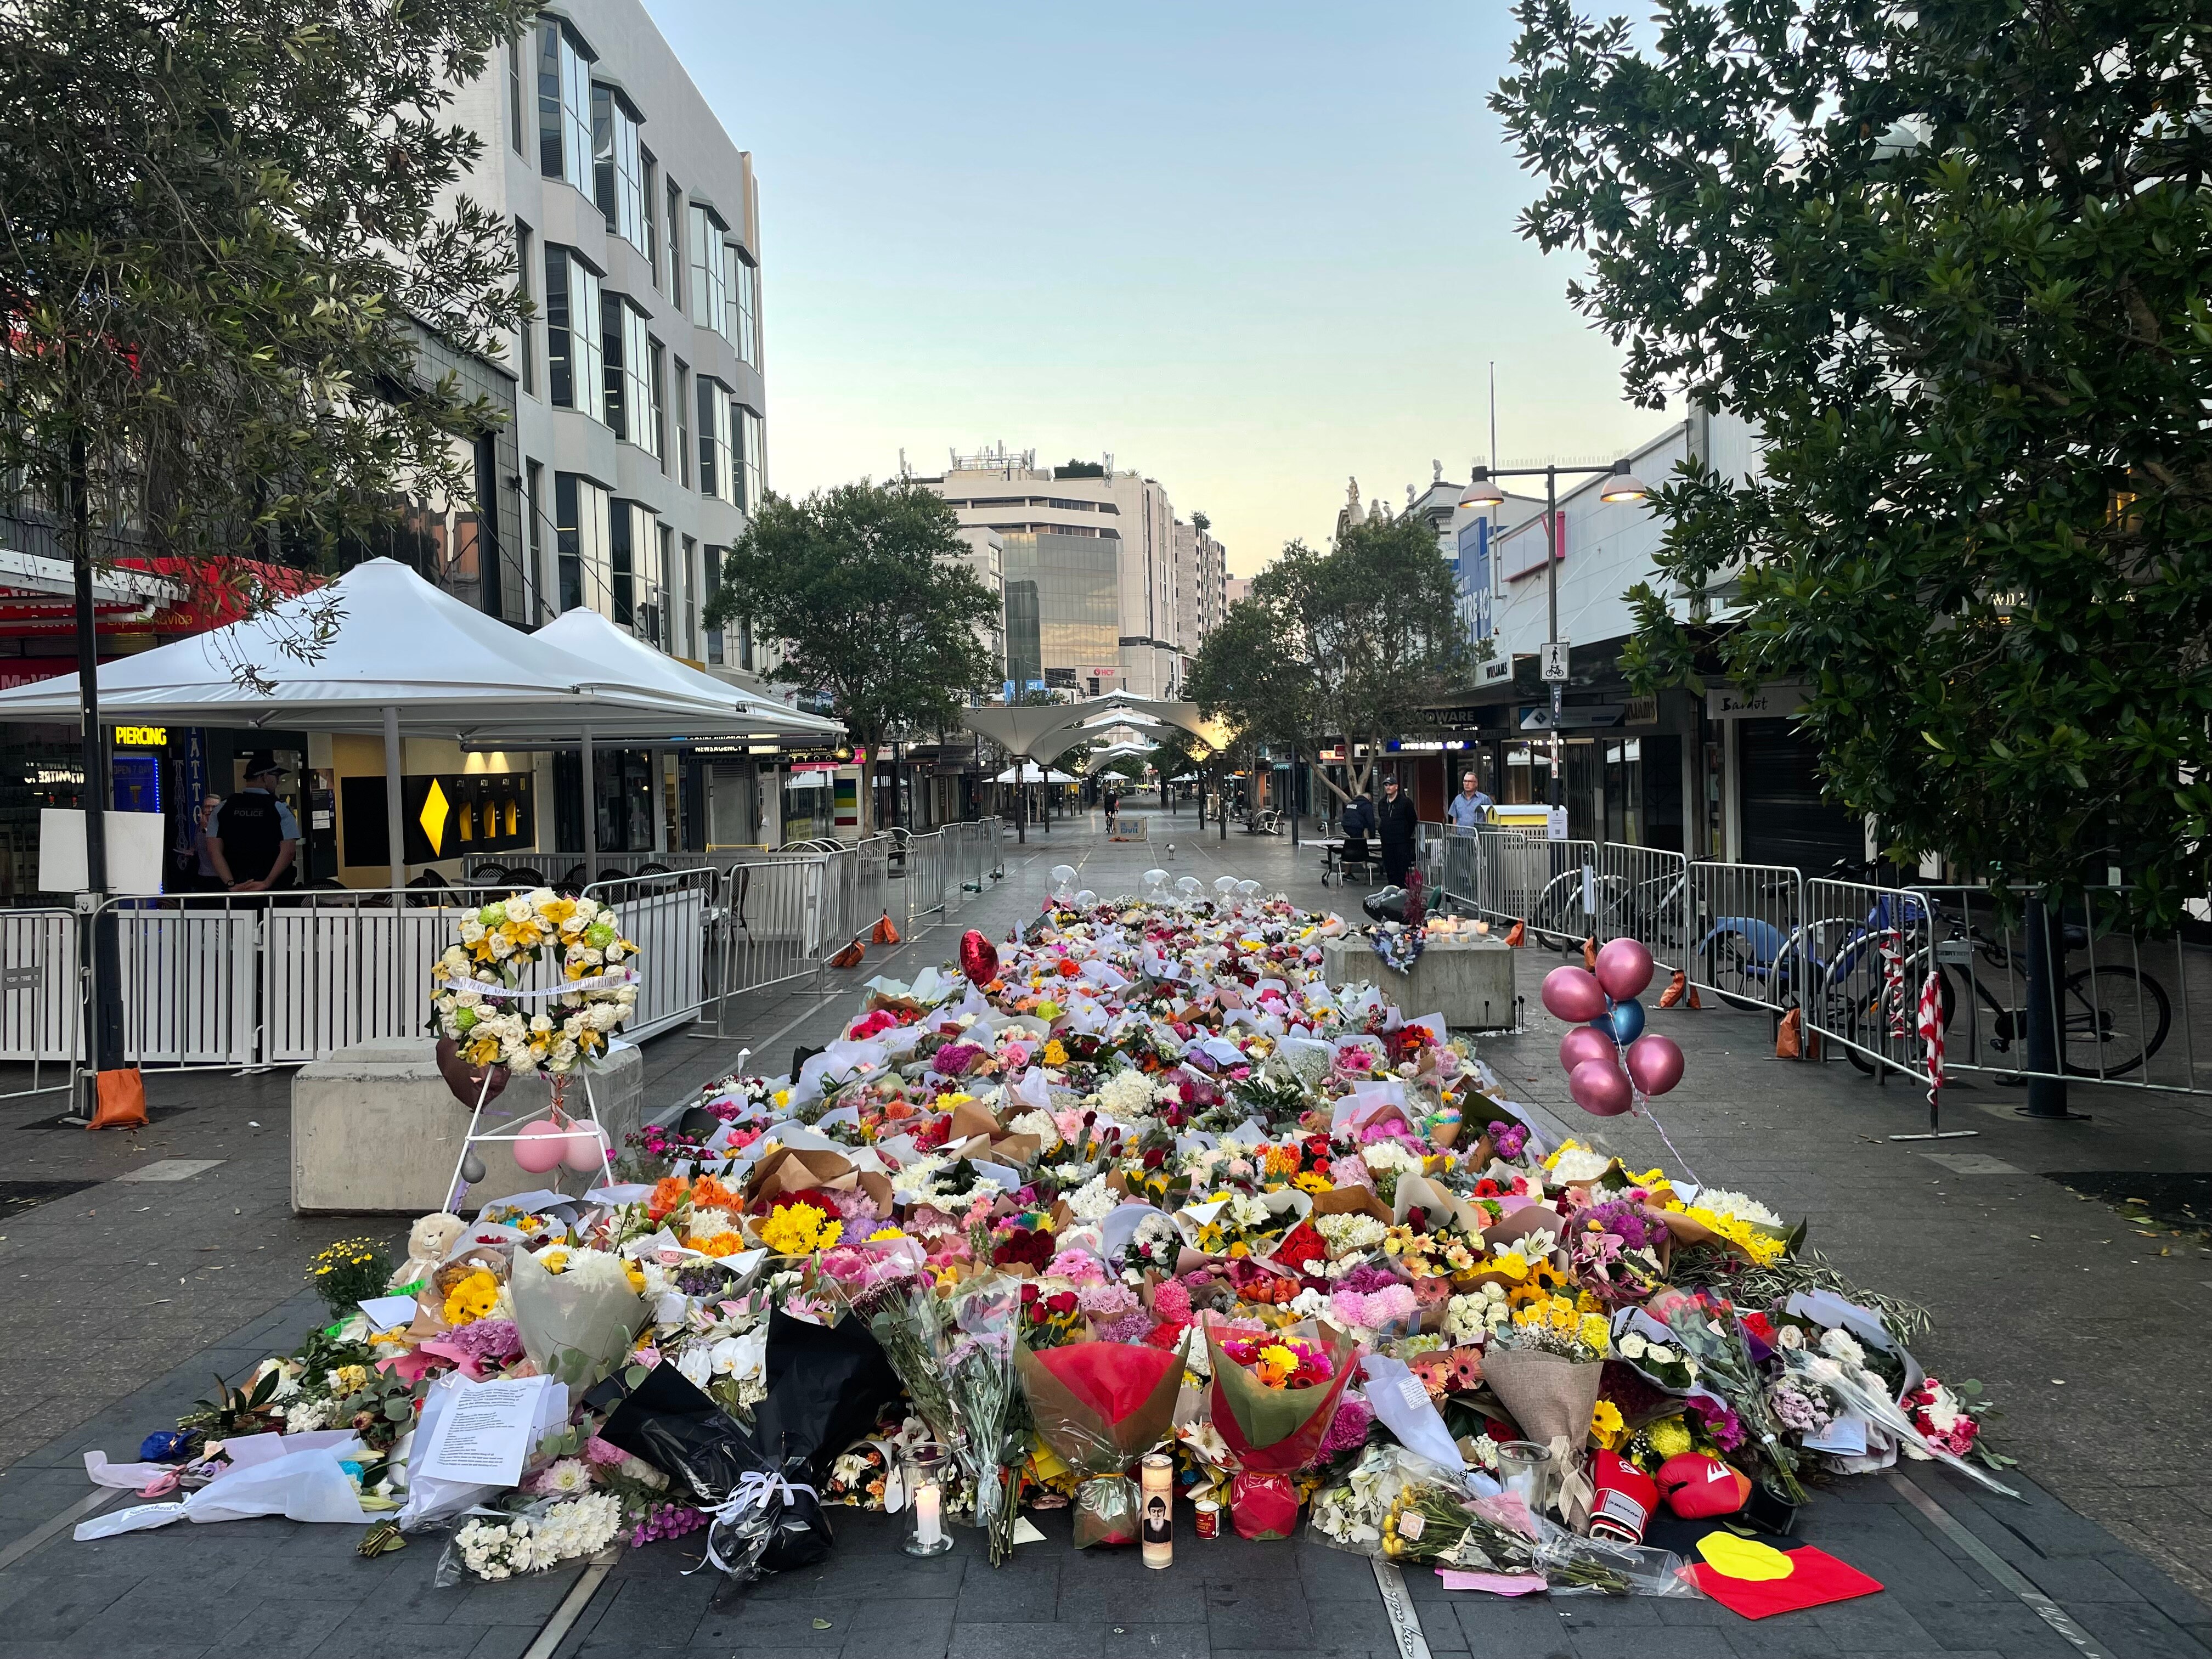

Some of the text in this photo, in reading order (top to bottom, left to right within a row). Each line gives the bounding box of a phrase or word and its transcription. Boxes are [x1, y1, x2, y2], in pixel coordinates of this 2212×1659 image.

[1101, 668, 1115, 676] HCF
[116, 726, 167, 745] PIERCING
[1383, 1592, 1404, 1623] you
[1402, 1625, 1424, 1657] been
